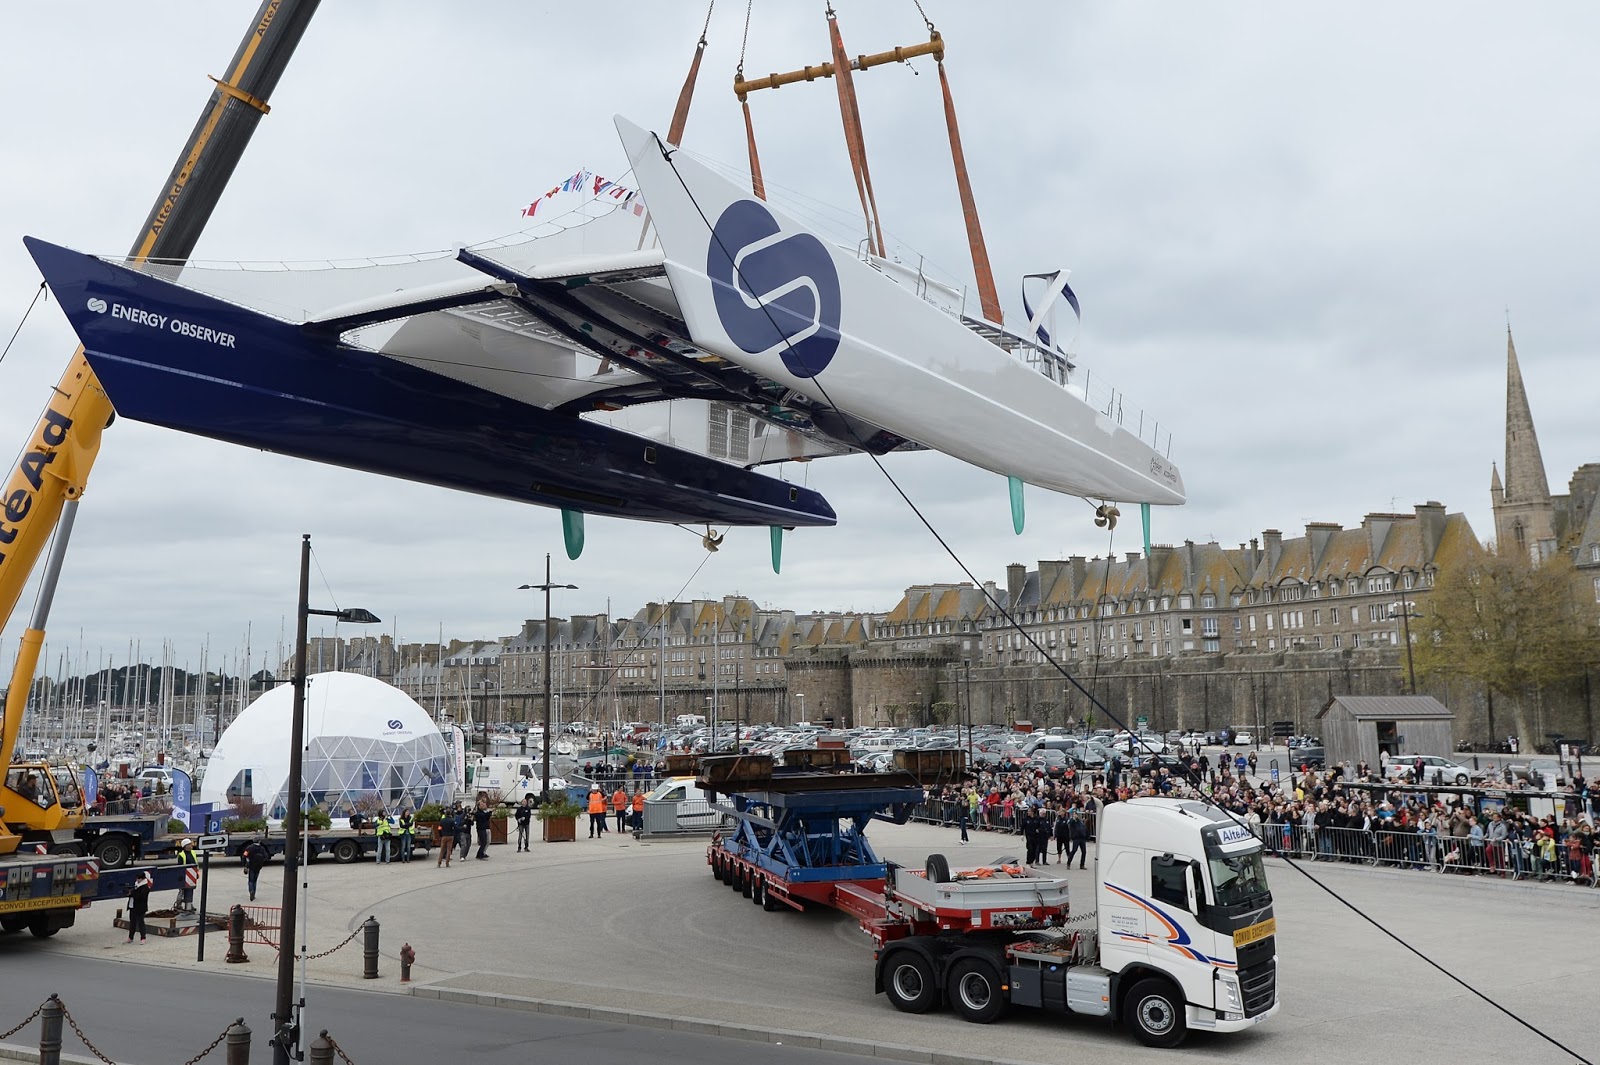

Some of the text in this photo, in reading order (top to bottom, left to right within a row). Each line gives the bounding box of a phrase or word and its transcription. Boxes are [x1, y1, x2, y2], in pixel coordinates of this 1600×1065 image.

[152, 183, 183, 236] AltéAd
[111, 303, 236, 349] ENERGY OBSERVER
[0, 408, 73, 565] téAd
[211, 821, 219, 832] P
[0, 897, 79, 910] CONVOI EXCEPTIONNEL
[1235, 929, 1251, 944] CONVOI
